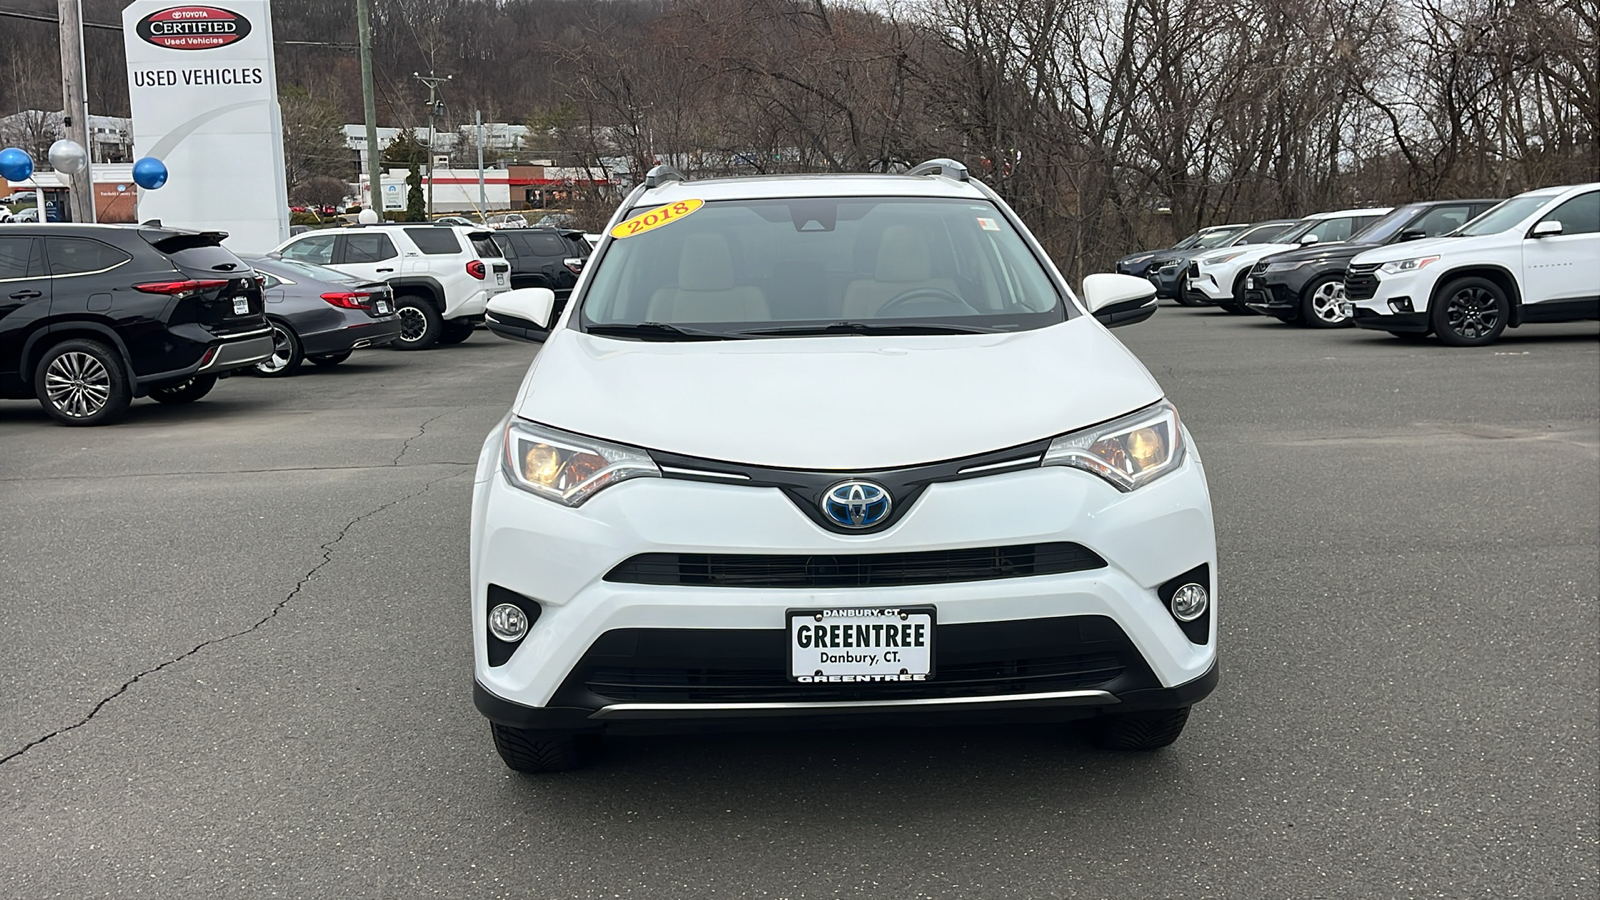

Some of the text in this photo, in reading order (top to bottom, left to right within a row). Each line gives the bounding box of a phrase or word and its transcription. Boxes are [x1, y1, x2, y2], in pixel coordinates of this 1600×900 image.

[150, 21, 237, 35] CERTIFIED
[164, 37, 224, 46] Used Vehicles
[134, 68, 263, 87] USED VEHICLES
[627, 202, 689, 234] 2018
[797, 624, 925, 649] GREENTREE
[820, 651, 901, 666] Danbury, CT.
[797, 674, 926, 683] GREENTREE
